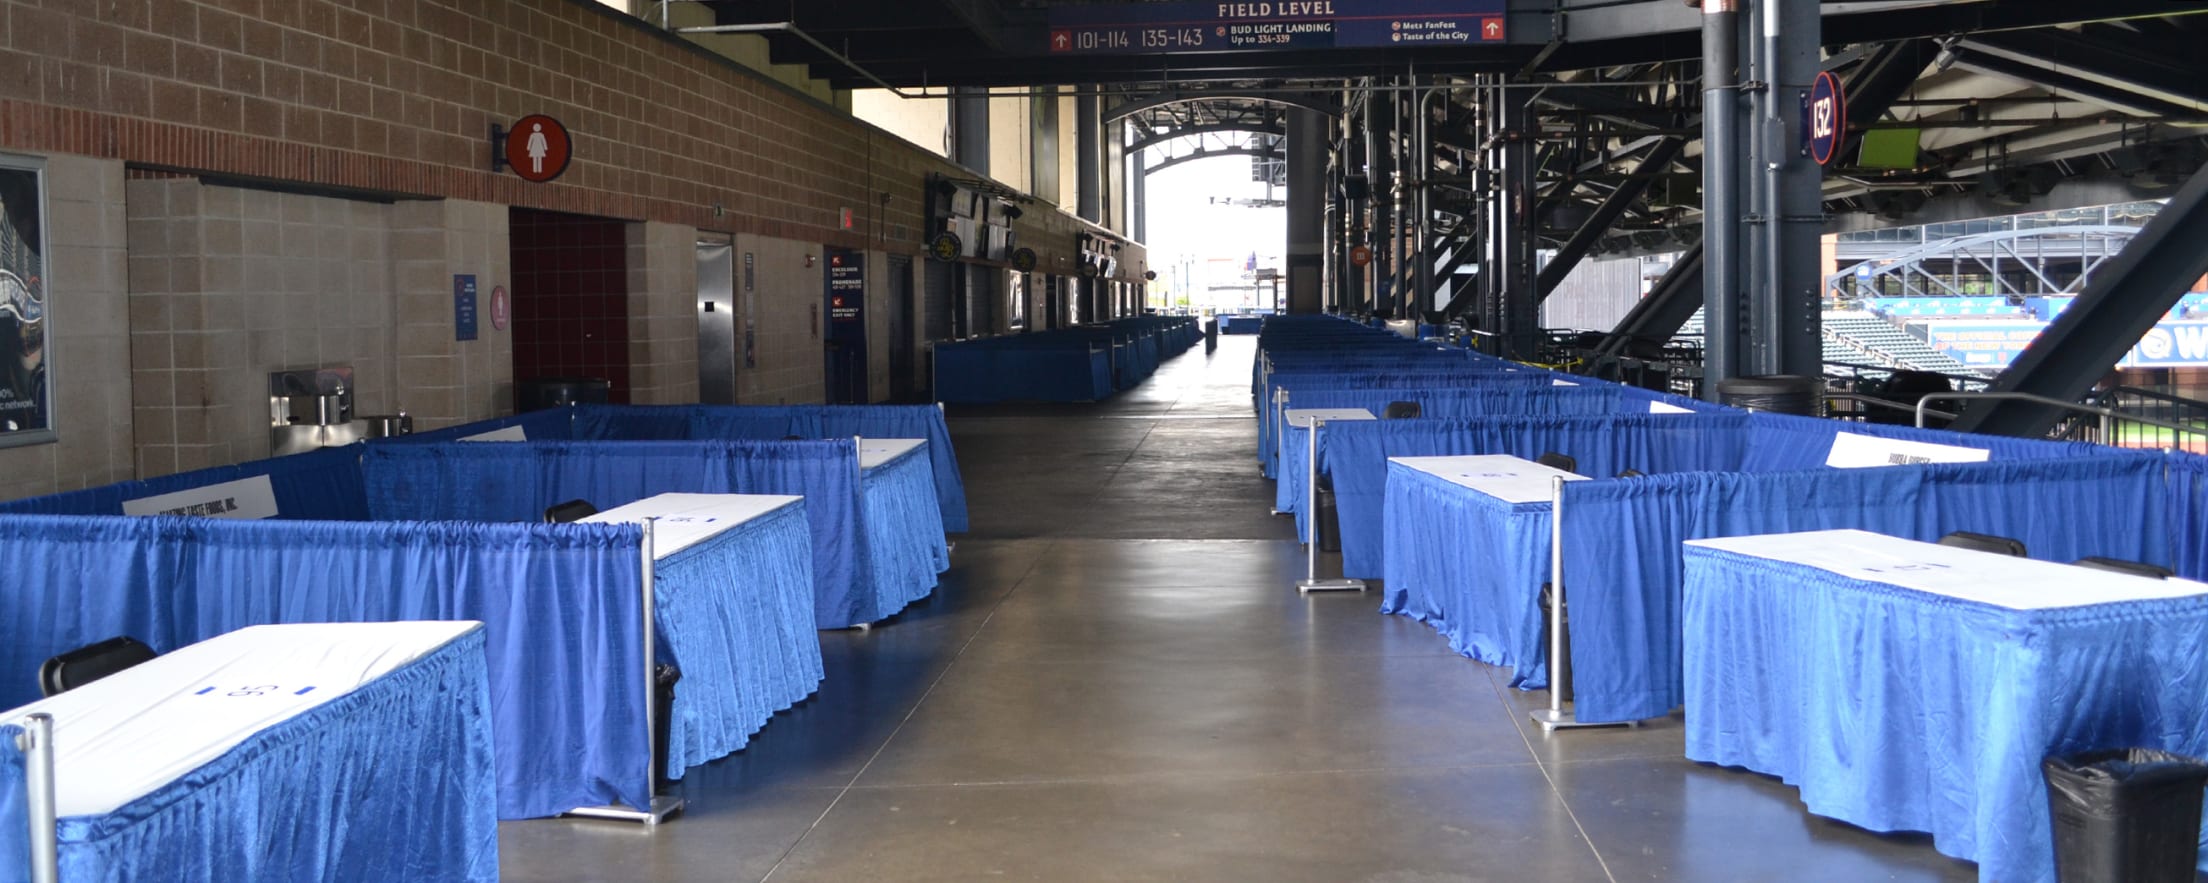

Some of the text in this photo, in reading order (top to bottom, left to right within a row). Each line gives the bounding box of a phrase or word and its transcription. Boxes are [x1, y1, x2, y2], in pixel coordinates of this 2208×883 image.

[1218, 1, 1334, 17] FIELD LEVEL
[1230, 23, 1331, 34] BUD LIGHT LANDING
[1402, 21, 1456, 30] Mets FanFest
[1077, 28, 1203, 48] 101-114 135-143
[1231, 35, 1243, 46] Up
[1402, 31, 1469, 41] Taste of the City
[1813, 96, 1832, 139] 132
[187, 504, 205, 516] TASTE
